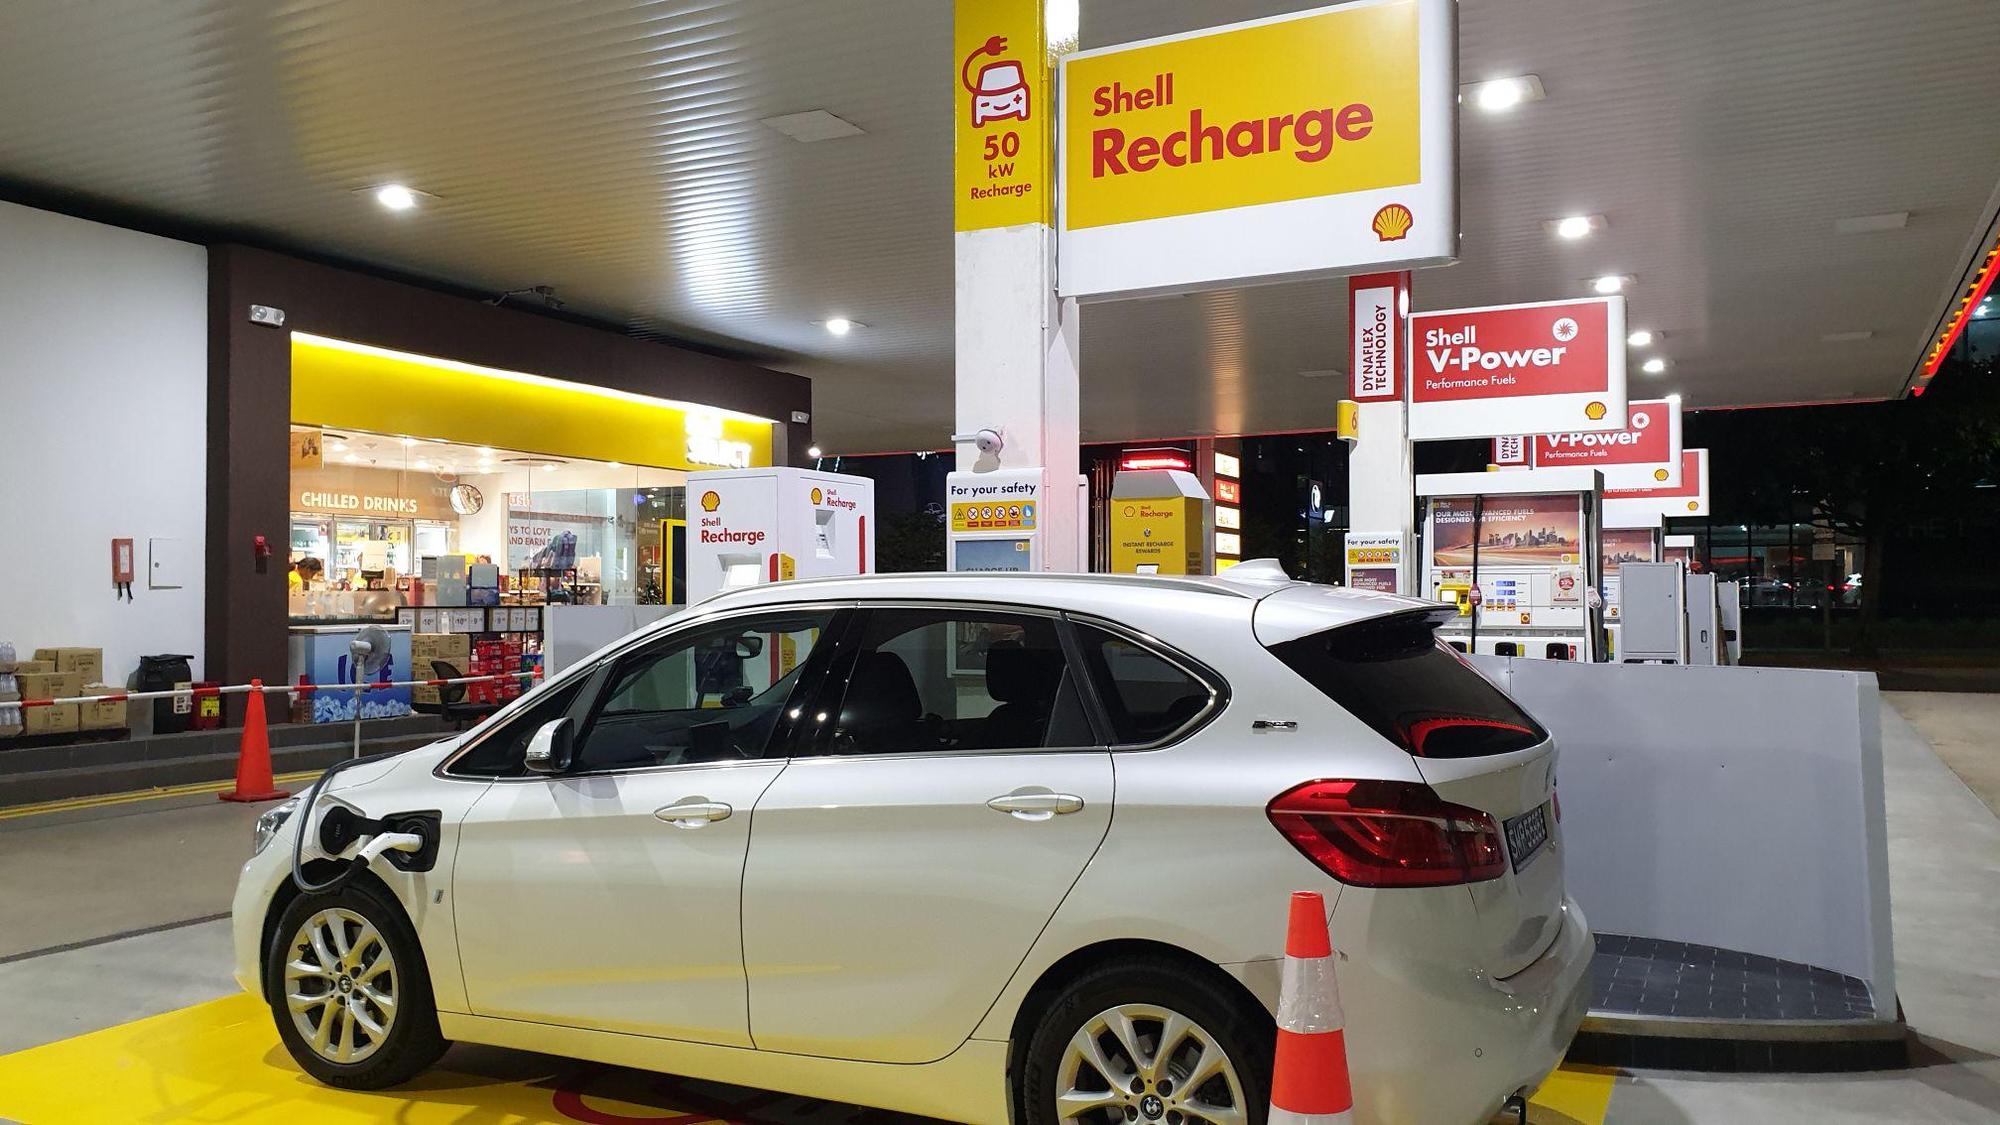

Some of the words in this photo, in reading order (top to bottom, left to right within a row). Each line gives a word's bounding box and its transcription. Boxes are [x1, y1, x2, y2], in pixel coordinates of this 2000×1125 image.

[1093, 72, 1174, 117] Shell
[983, 131, 1020, 161] 50
[1092, 103, 1374, 179] Recharge
[988, 162, 1015, 179] kW
[970, 183, 1032, 200] Recharge
[1425, 325, 1477, 347] Shell
[1375, 304, 1387, 391] TECHNOLOGY
[1362, 327, 1374, 391] DYNAFLEX
[1426, 346, 1567, 373] V-Power
[1425, 378, 1489, 390] Performance
[1491, 373, 1517, 385] Fuels
[1546, 432, 1642, 448] V-Power
[1544, 450, 1589, 459] Performance
[1589, 449, 1609, 457] Fuels
[951, 486, 968, 496] For
[972, 486, 998, 498] your
[1001, 482, 1037, 495] safety
[301, 491, 359, 509] CHILLED
[363, 496, 418, 513] DRINKS
[826, 496, 857, 510] Recharge
[701, 517, 721, 527] Shell
[1140, 510, 1174, 518] Recharge
[520, 527, 531, 535] TO
[533, 527, 551, 536] LOVE
[701, 528, 765, 545] Recharge
[525, 537, 545, 546] EARN
[1360, 539, 1376, 547] your
[1378, 538, 1400, 546] safety
